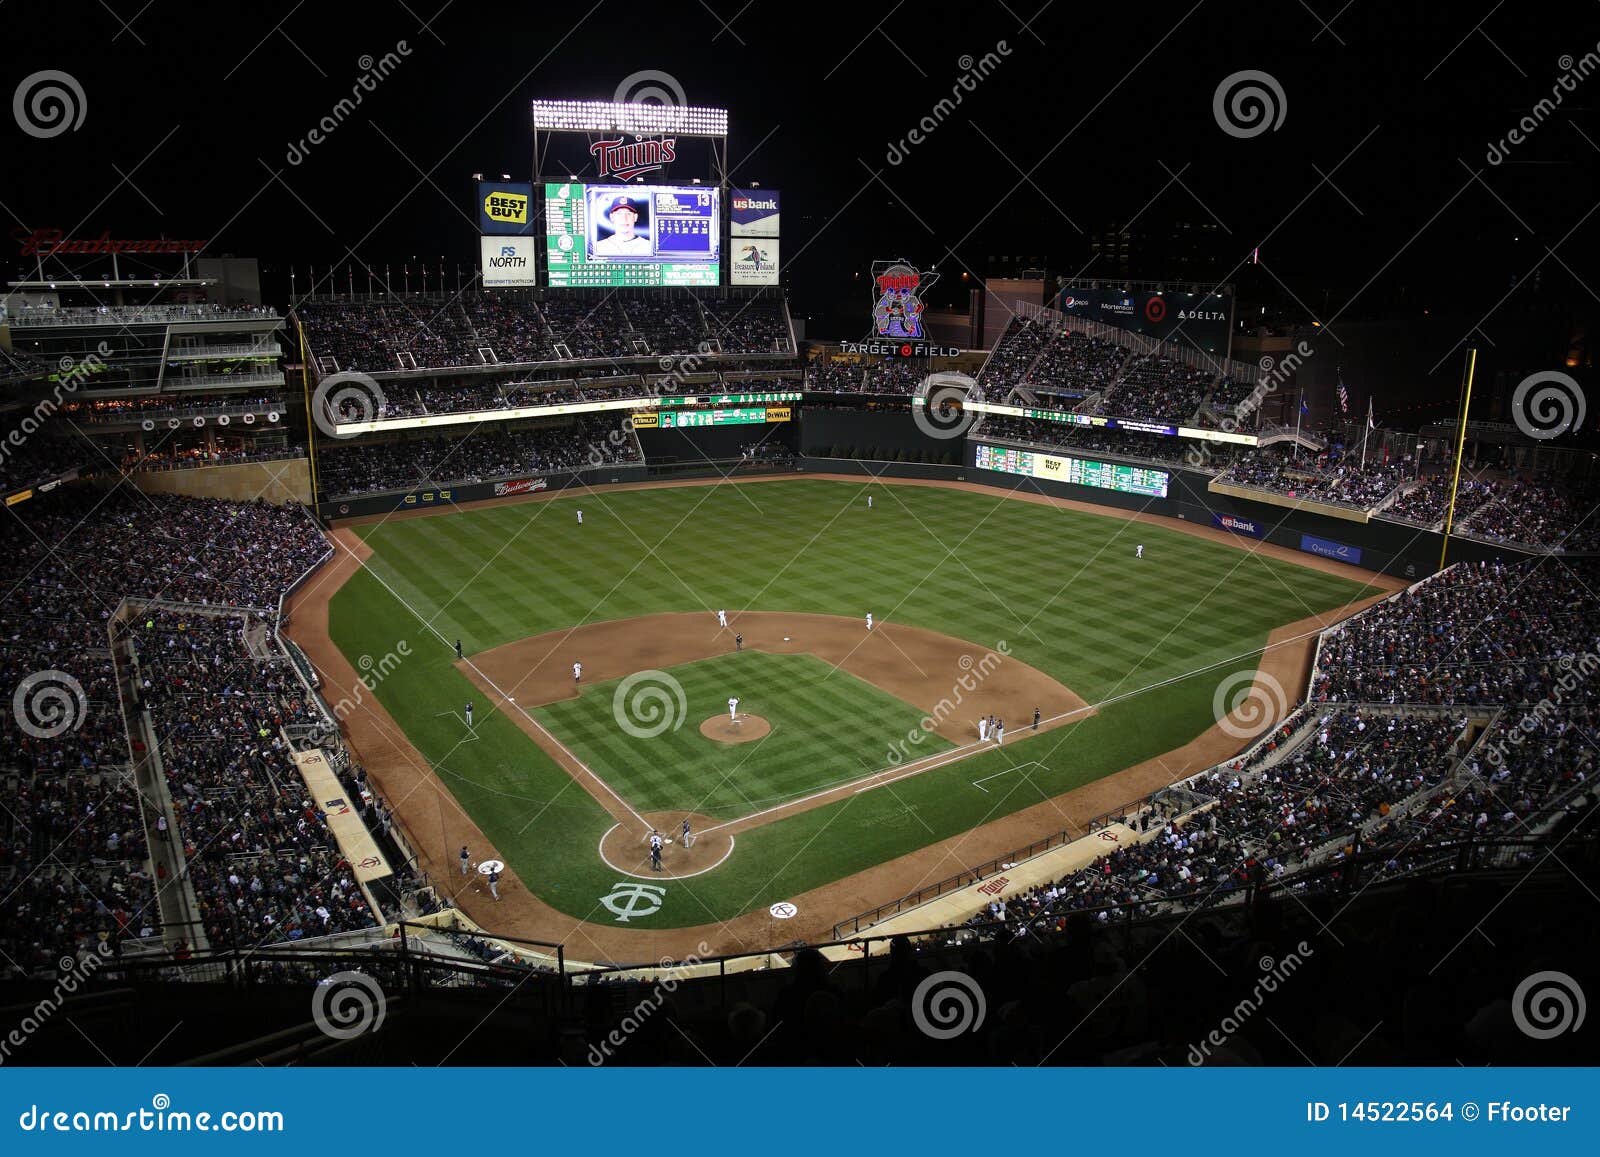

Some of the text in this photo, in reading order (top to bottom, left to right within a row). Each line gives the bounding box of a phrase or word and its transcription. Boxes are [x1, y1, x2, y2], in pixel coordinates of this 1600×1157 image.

[590, 135, 675, 181] Twins
[490, 197, 526, 209] BEST
[491, 207, 523, 218] BUY
[501, 247, 516, 256] FS
[489, 257, 527, 267] NORTH
[1101, 303, 1134, 311] Mortenson
[1189, 311, 1226, 321] DELTA
[840, 343, 960, 357] TARGET FIELD
[1045, 459, 1061, 467] BEST
[500, 478, 546, 496] Budweiser
[977, 876, 1010, 896] Twins
